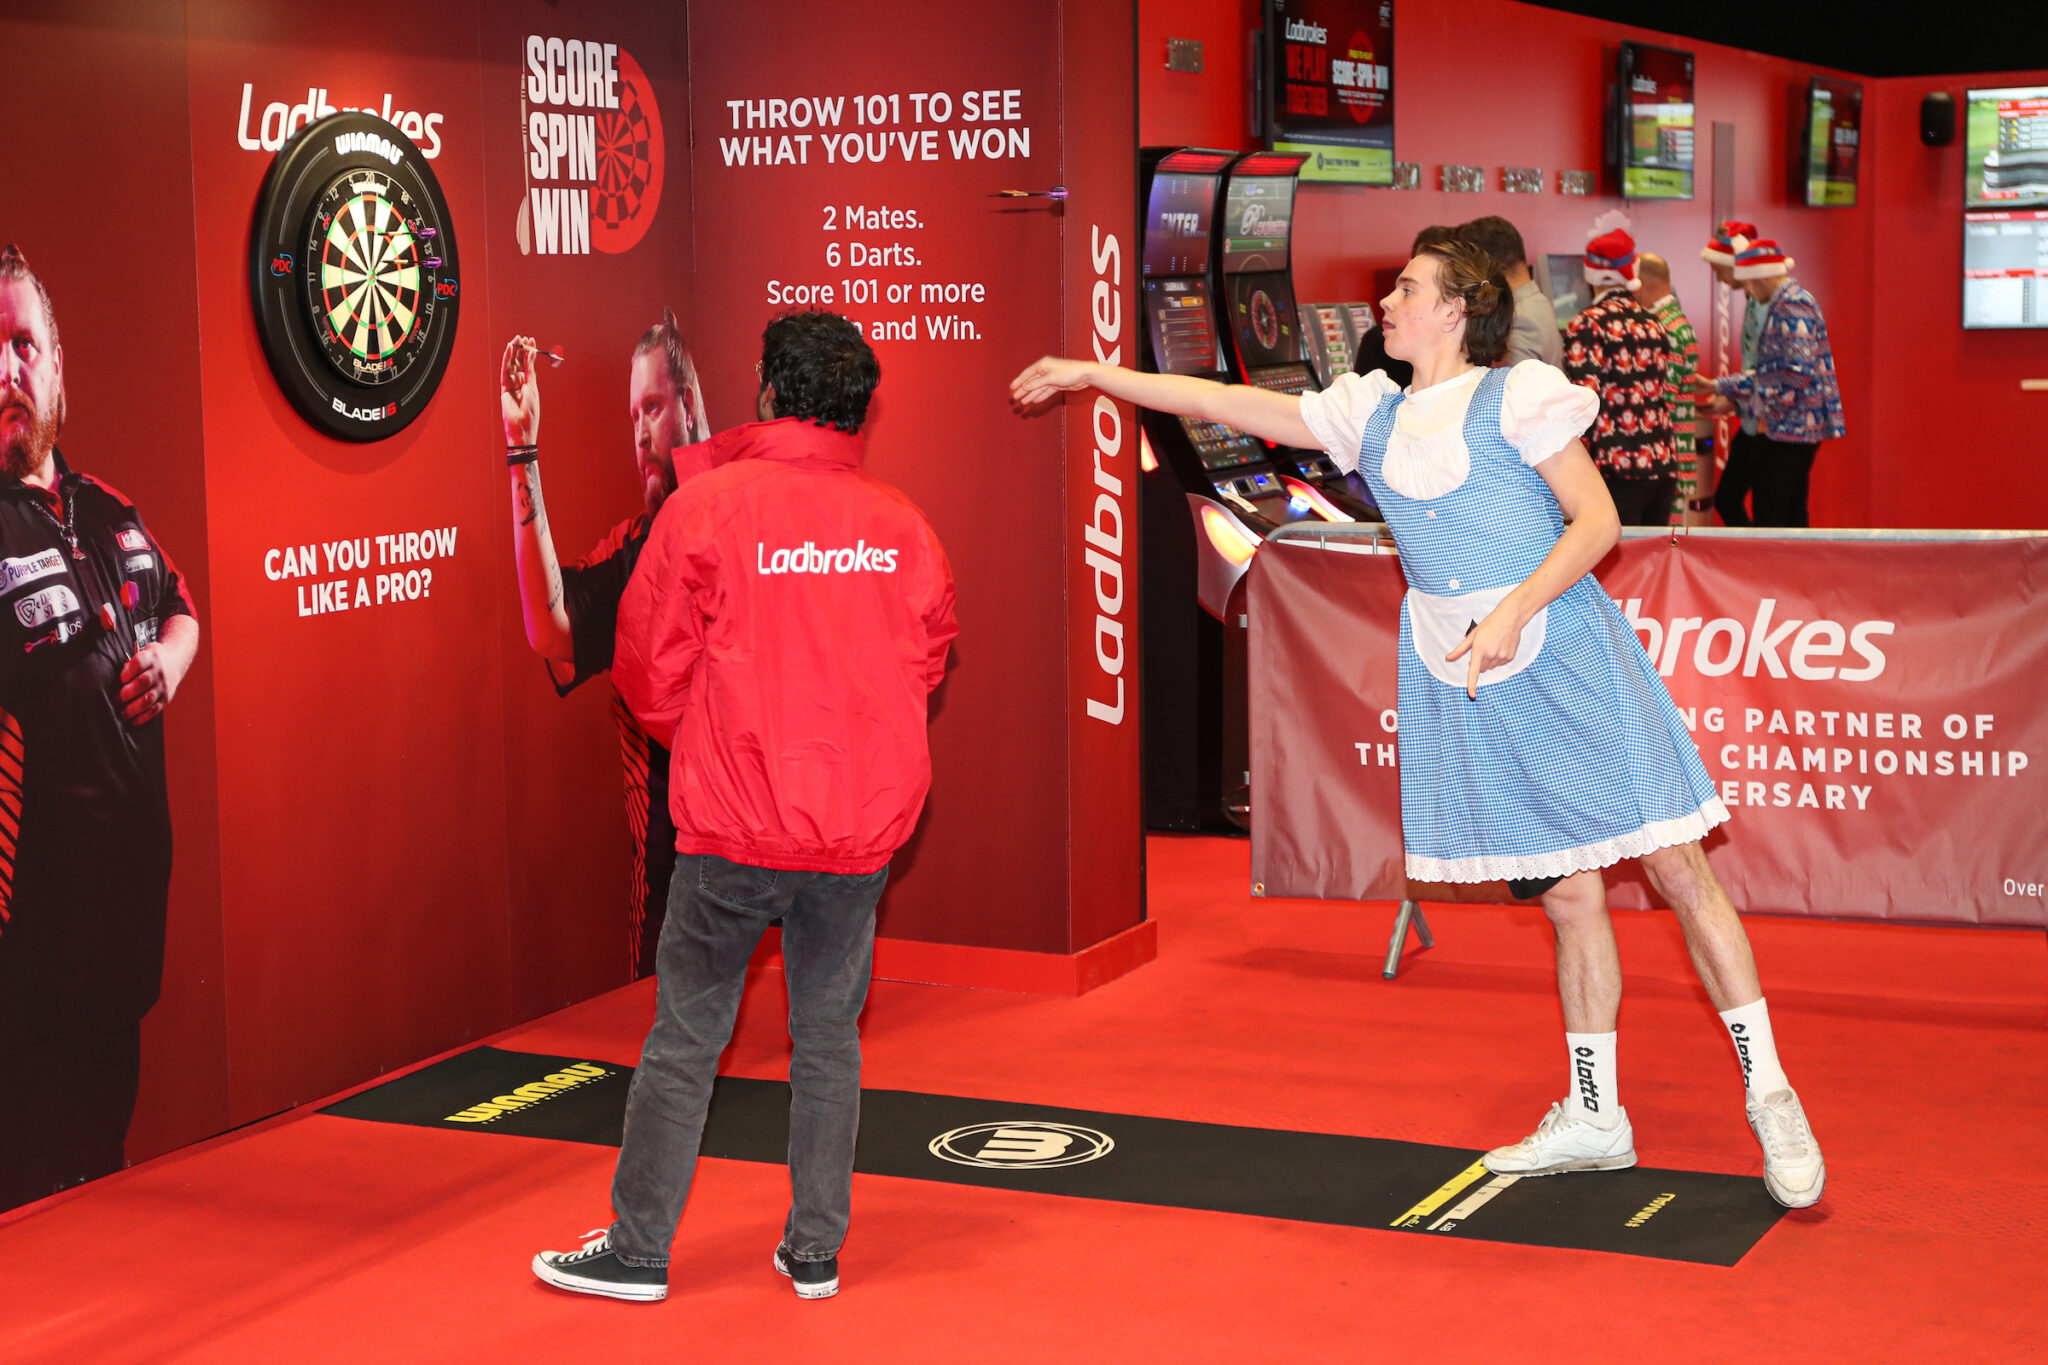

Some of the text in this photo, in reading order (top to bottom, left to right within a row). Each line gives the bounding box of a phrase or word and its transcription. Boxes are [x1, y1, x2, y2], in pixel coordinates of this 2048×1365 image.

[527, 35, 619, 109] SCORE
[238, 83, 443, 159] Ladbkes
[727, 89, 1021, 130] THROW 101 TO SEE
[335, 131, 404, 165] WINMAU
[529, 111, 597, 181] SPIN
[719, 127, 1030, 167] WHAT YOU'VE WON
[531, 187, 590, 255] WIN
[823, 205, 924, 231] 2 Mates.
[273, 258, 292, 273] PDC
[826, 242, 922, 267] 6 Darts.
[437, 283, 457, 297] PDC
[766, 279, 986, 305] Score 101 or more
[871, 315, 917, 341] and
[925, 315, 981, 341] Win.
[8, 554, 63, 581] PURPLE TARGET
[264, 526, 458, 581] CAN YOU THROW
[757, 539, 899, 575] Ladbrokes
[298, 568, 433, 617] LIKE A PRO?
[1612, 598, 1895, 682] brokes
[1745, 708, 1922, 739] PARTNER
[1943, 713, 1994, 740] OF
[1355, 742, 2029, 777] TH CHAMPIONSHIP
[1713, 781, 1872, 811] ERSARY
[2003, 878, 2045, 897] Over
[443, 1062, 606, 1123] WINMAU
